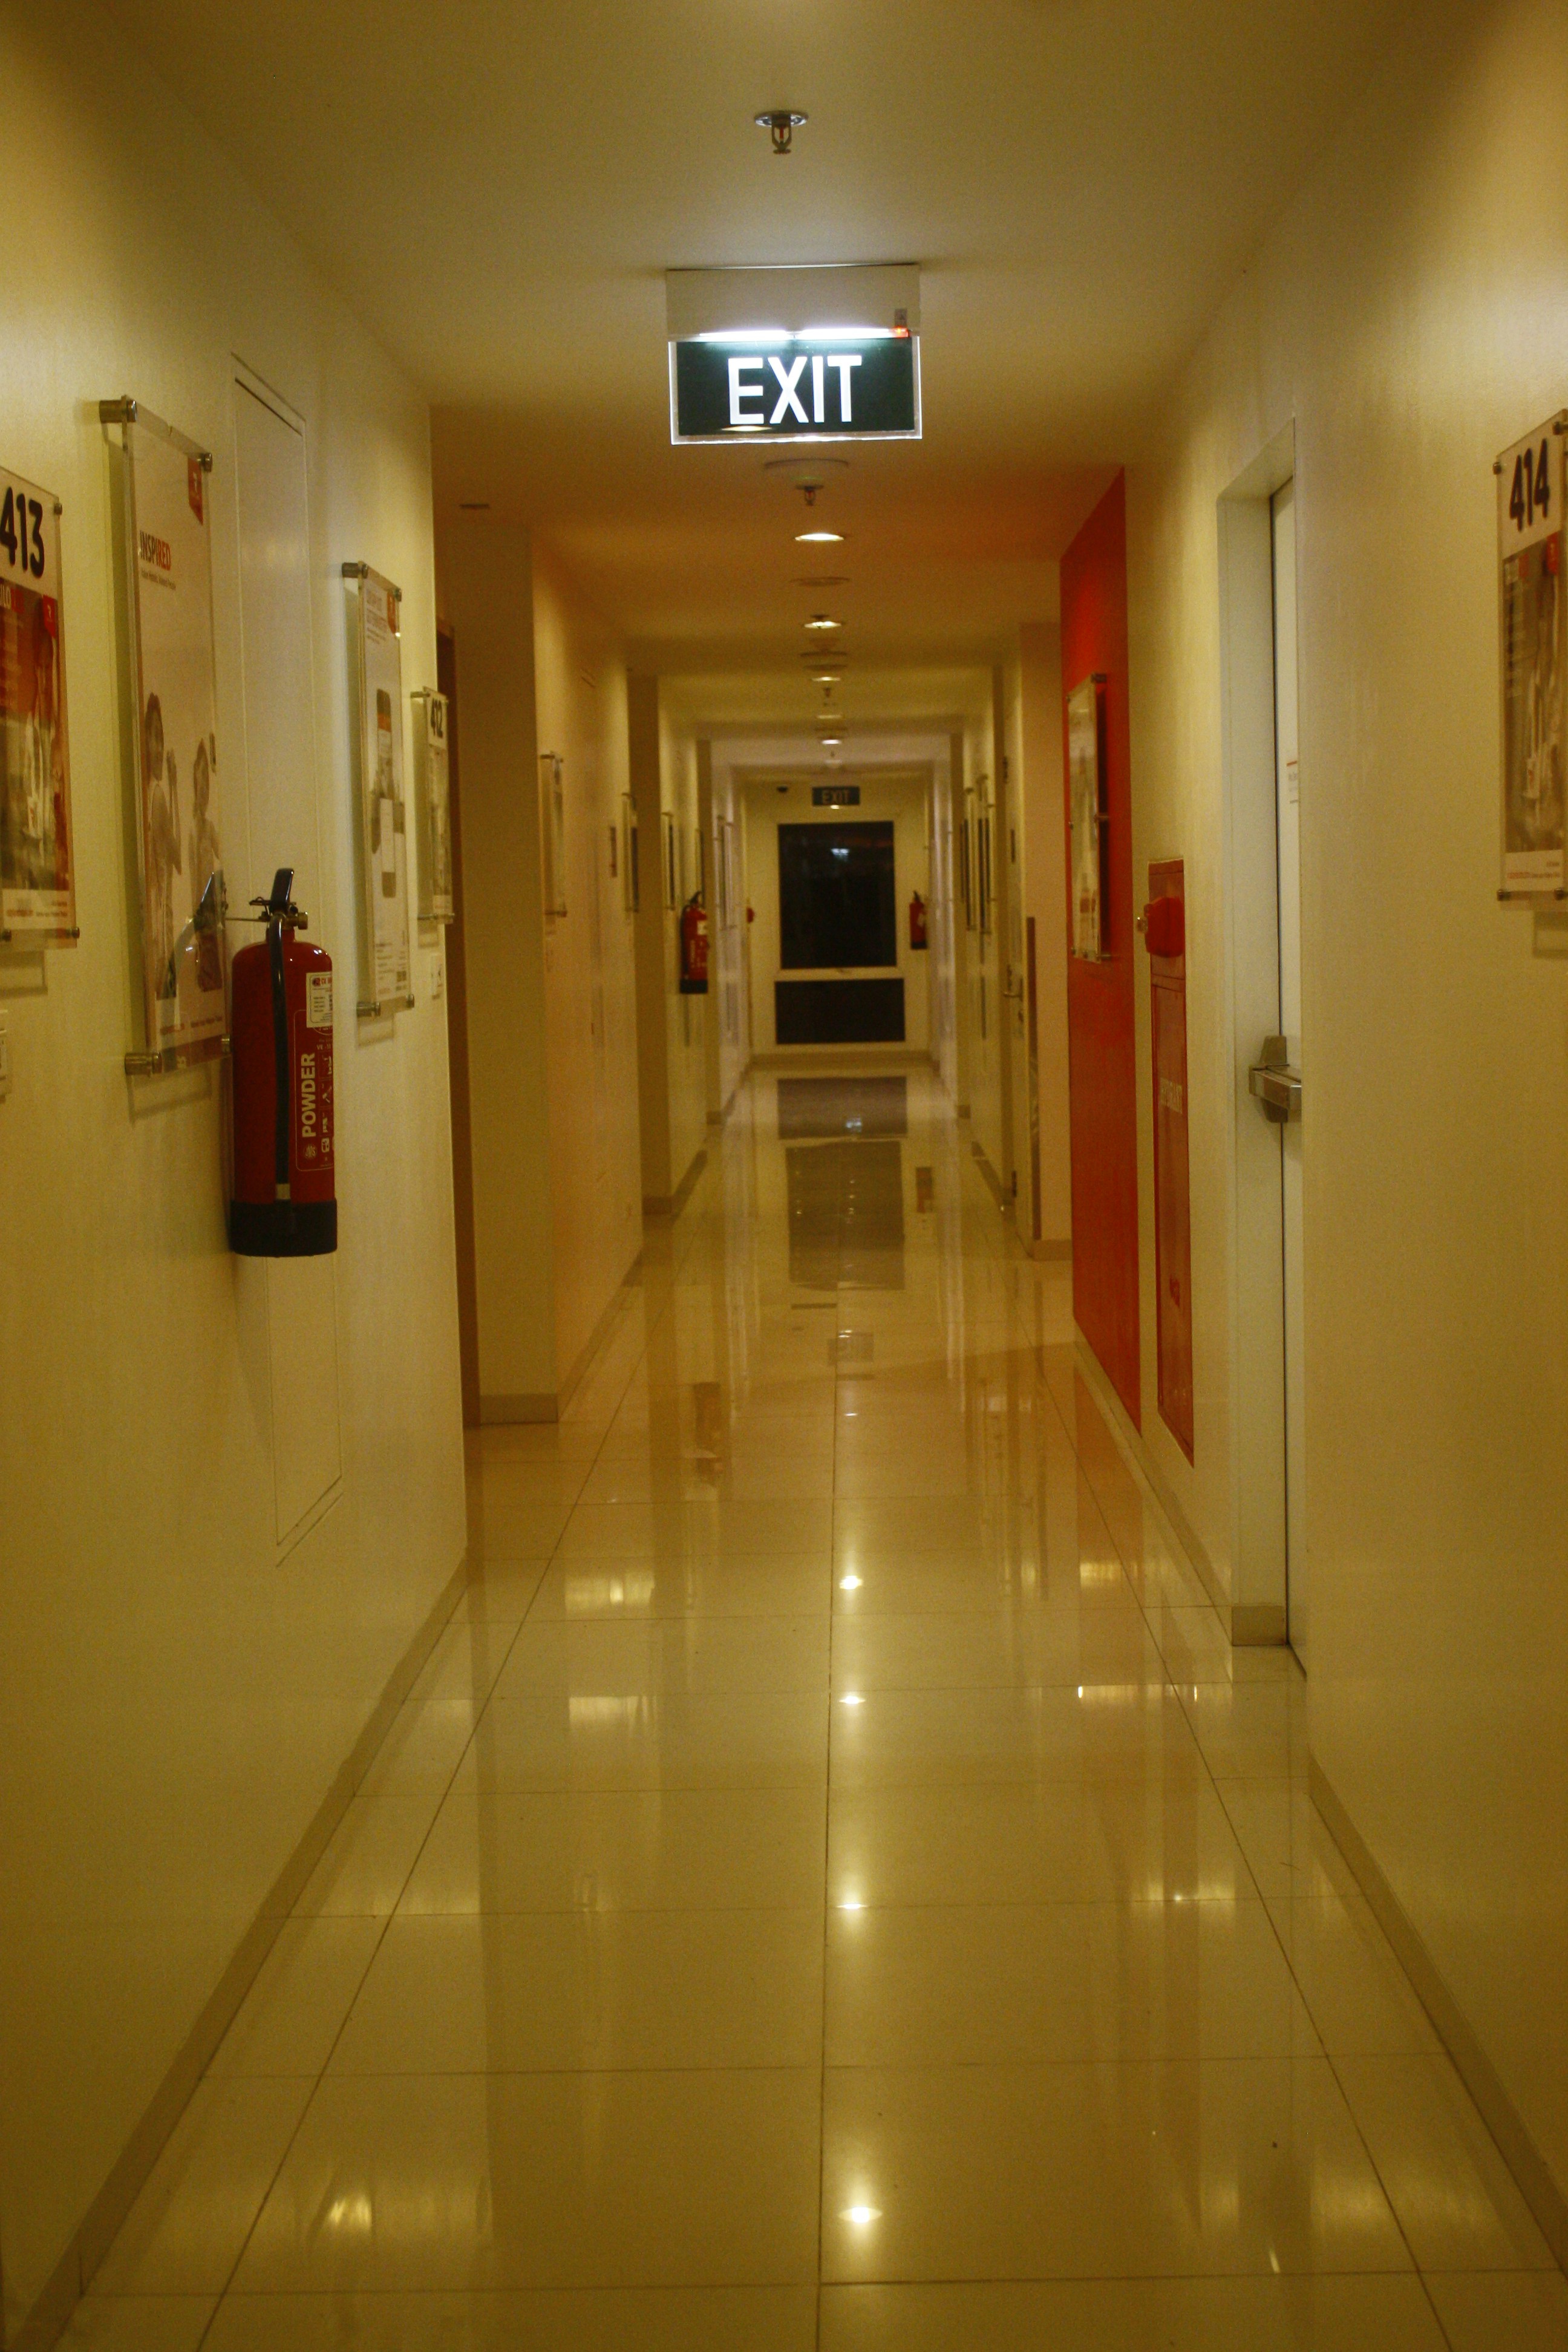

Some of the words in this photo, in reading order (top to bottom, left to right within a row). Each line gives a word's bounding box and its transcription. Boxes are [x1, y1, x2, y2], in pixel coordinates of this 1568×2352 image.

[728, 355, 862, 425] EXIT
[1509, 437, 1549, 532] 414
[0, 486, 45, 579] 413
[140, 530, 171, 571] INSPIRED
[430, 697, 443, 739] 412
[822, 789, 851, 803] EXIT
[301, 1053, 316, 1138] POWDER
